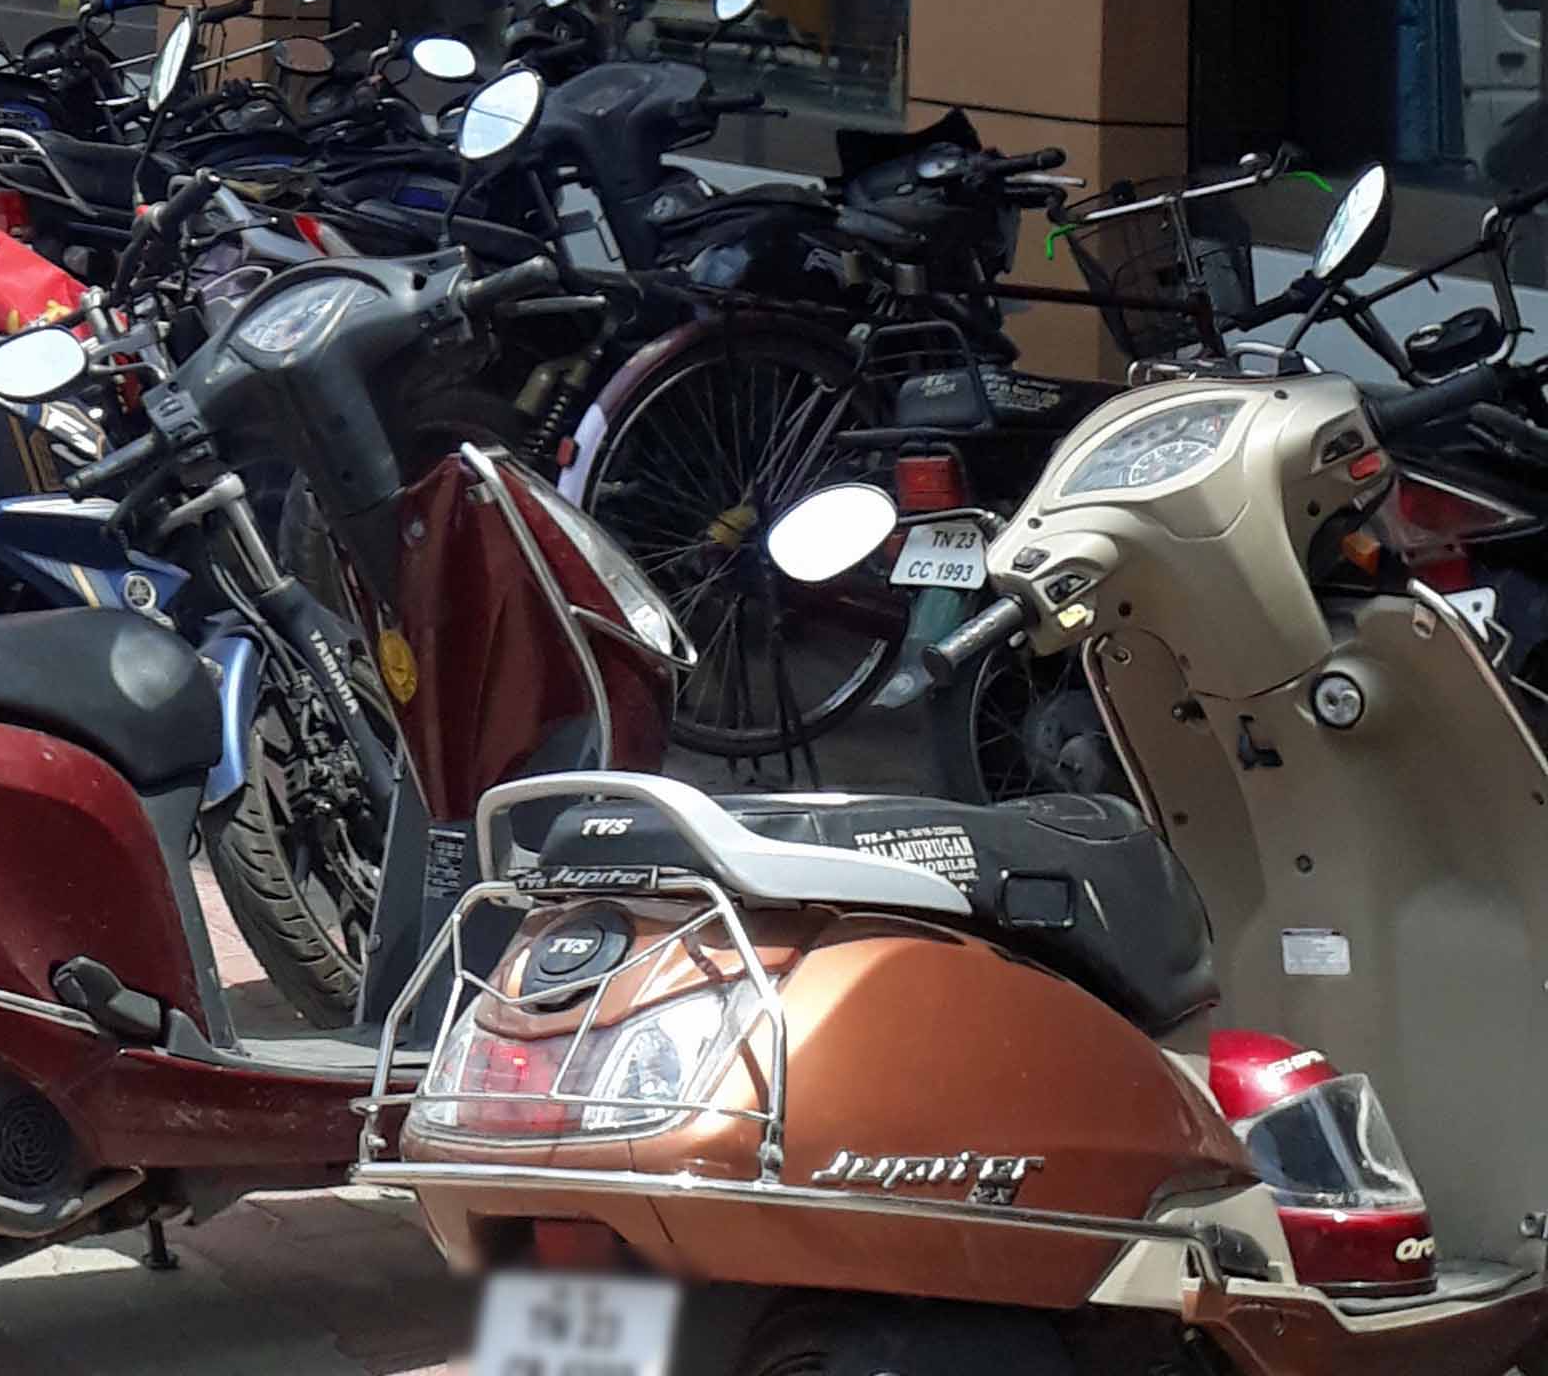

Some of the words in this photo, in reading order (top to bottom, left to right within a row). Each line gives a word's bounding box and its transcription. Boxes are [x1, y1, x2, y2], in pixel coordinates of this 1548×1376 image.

[933, 530, 955, 548] TN
[955, 531, 977, 549] 23
[908, 560, 933, 579] CC
[935, 562, 975, 582] 1993
[310, 629, 359, 715] YAMAHA
[581, 818, 633, 836] TVS
[551, 865, 649, 886] Jupiter
[548, 937, 595, 954] TVS
[811, 1150, 1045, 1189] Jupiter
